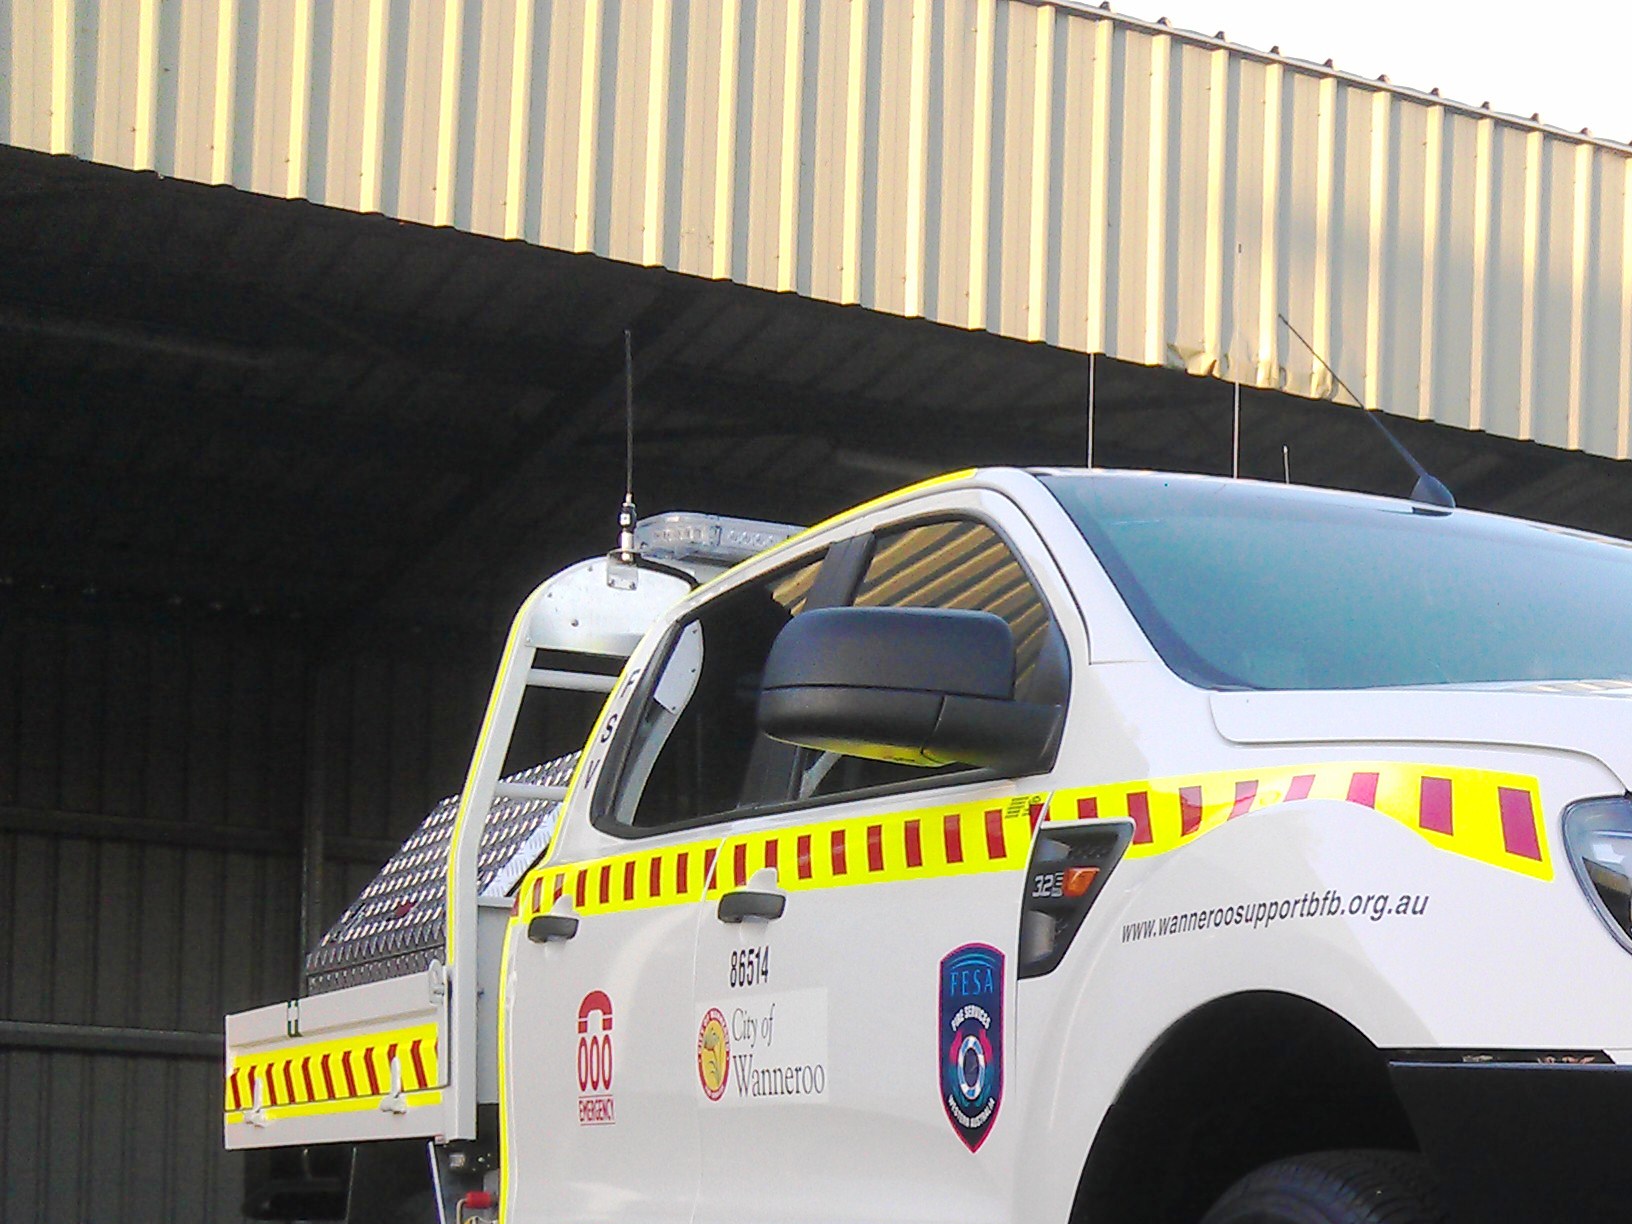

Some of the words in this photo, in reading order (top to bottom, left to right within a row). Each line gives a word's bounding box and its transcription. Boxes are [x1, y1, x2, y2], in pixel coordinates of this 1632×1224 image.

[1121, 889, 1430, 943] www.wanneroosupportbfb.org.au
[729, 945, 770, 988] 86514
[951, 968, 994, 996] FESA
[732, 1008, 758, 1048] City
[761, 1003, 776, 1047] of
[578, 1034, 613, 1092] 000
[732, 1054, 826, 1098] Wanneroo
[579, 1098, 615, 1122] EMERGENCY
